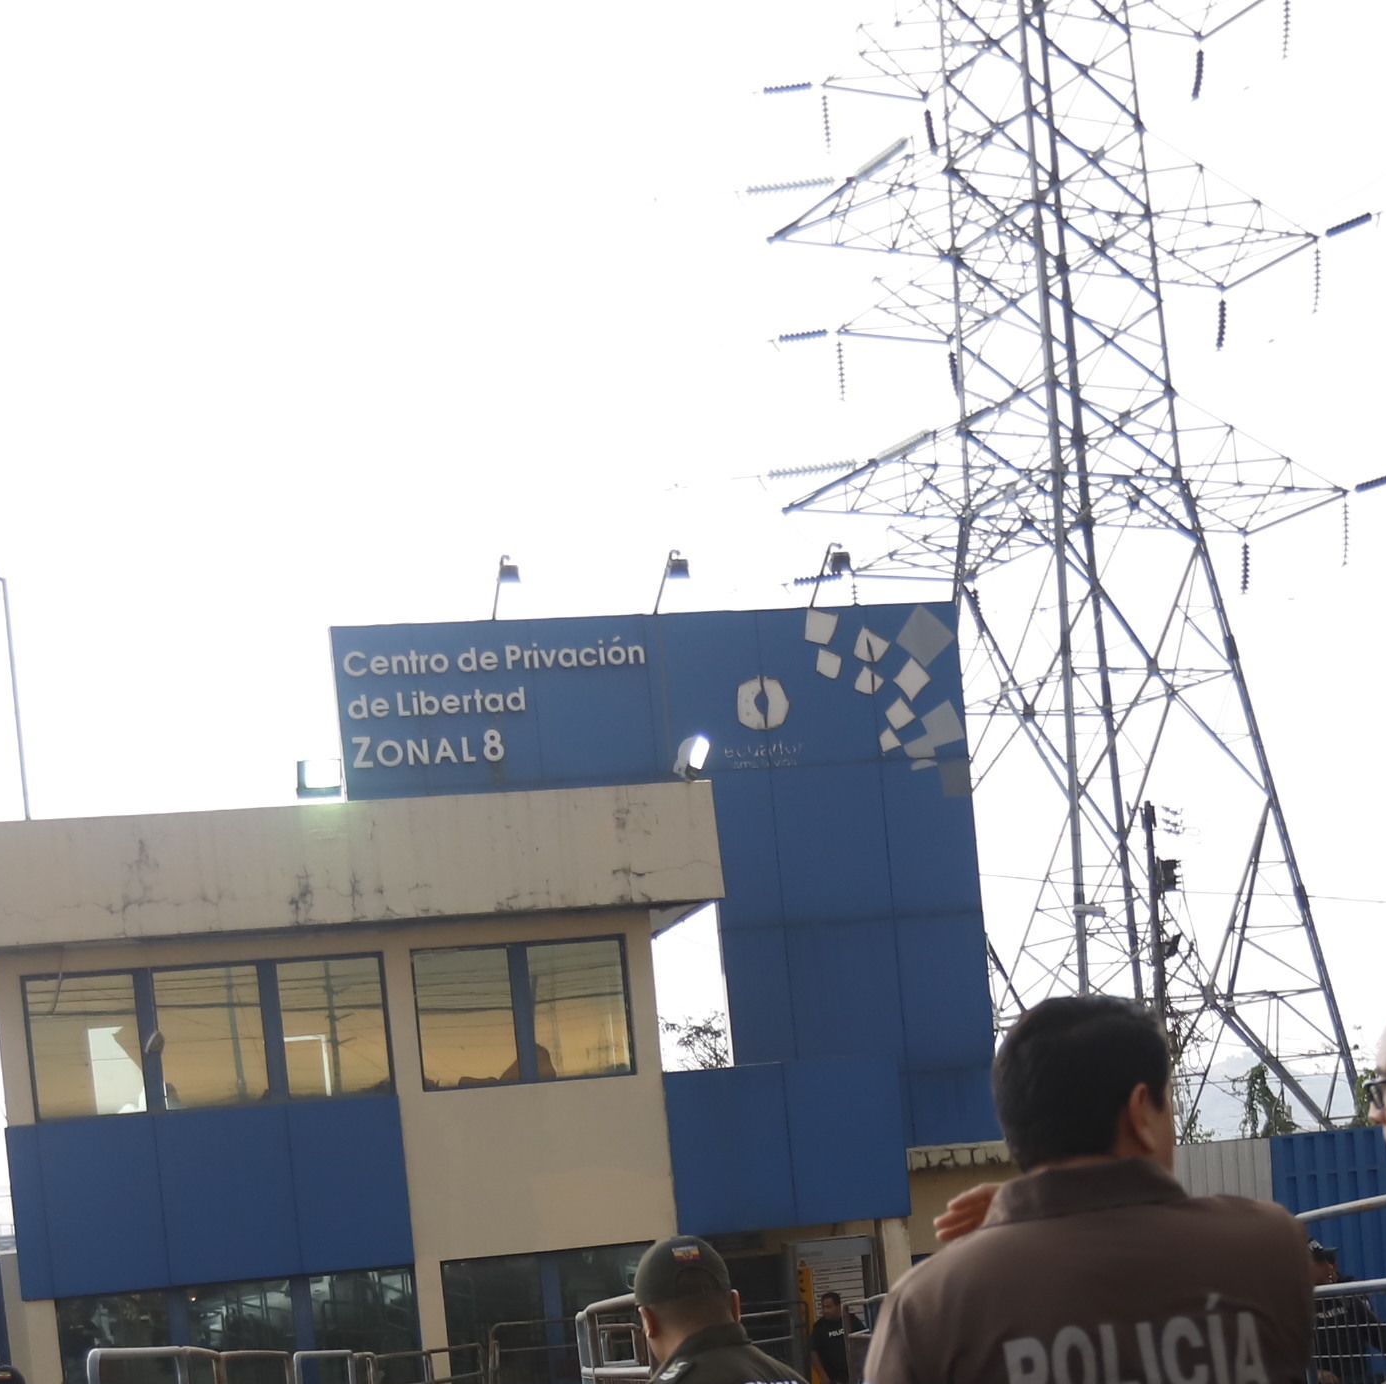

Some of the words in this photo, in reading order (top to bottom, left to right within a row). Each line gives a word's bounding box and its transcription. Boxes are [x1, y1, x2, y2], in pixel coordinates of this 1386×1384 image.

[343, 649, 449, 677] Centro
[457, 647, 499, 673] de
[504, 635, 646, 670] Privación
[347, 694, 390, 720] de
[396, 686, 526, 717] Libertad
[351, 736, 477, 769] ZONAL
[483, 728, 505, 762] 8
